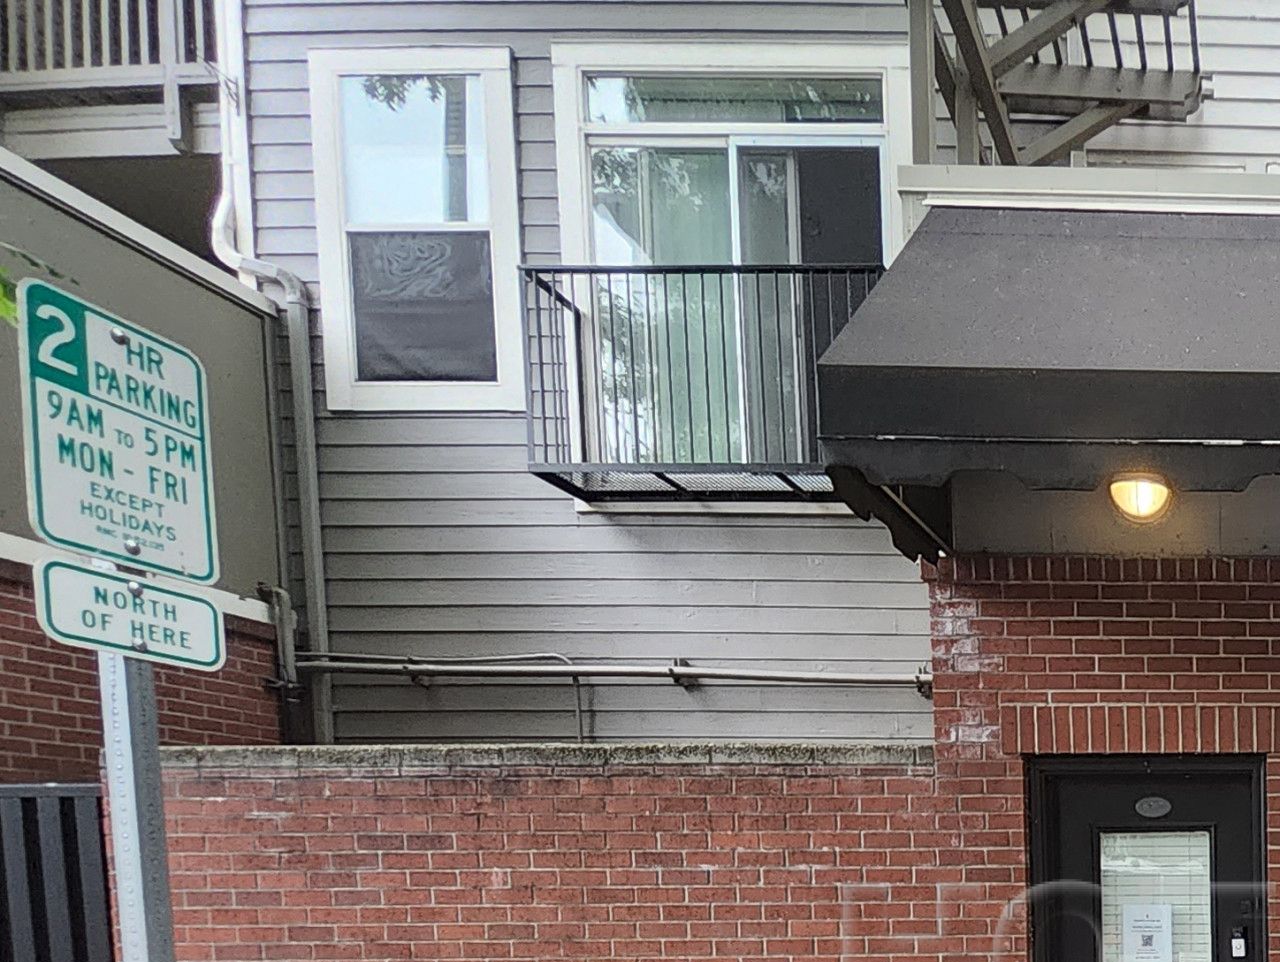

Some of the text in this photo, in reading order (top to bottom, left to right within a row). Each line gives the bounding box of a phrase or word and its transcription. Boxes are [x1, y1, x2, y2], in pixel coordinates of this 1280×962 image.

[35, 303, 78, 376] 2
[126, 341, 164, 379] HR
[94, 361, 197, 428] PARKING
[47, 389, 196, 472] 9AM TO 5PM
[57, 433, 114, 480] MON
[149, 466, 187, 504] FRI
[80, 499, 177, 542] HOLIDAYS
[90, 481, 165, 519] EXCEPT
[93, 585, 177, 622] NORTH
[82, 609, 192, 650] OF HERE
